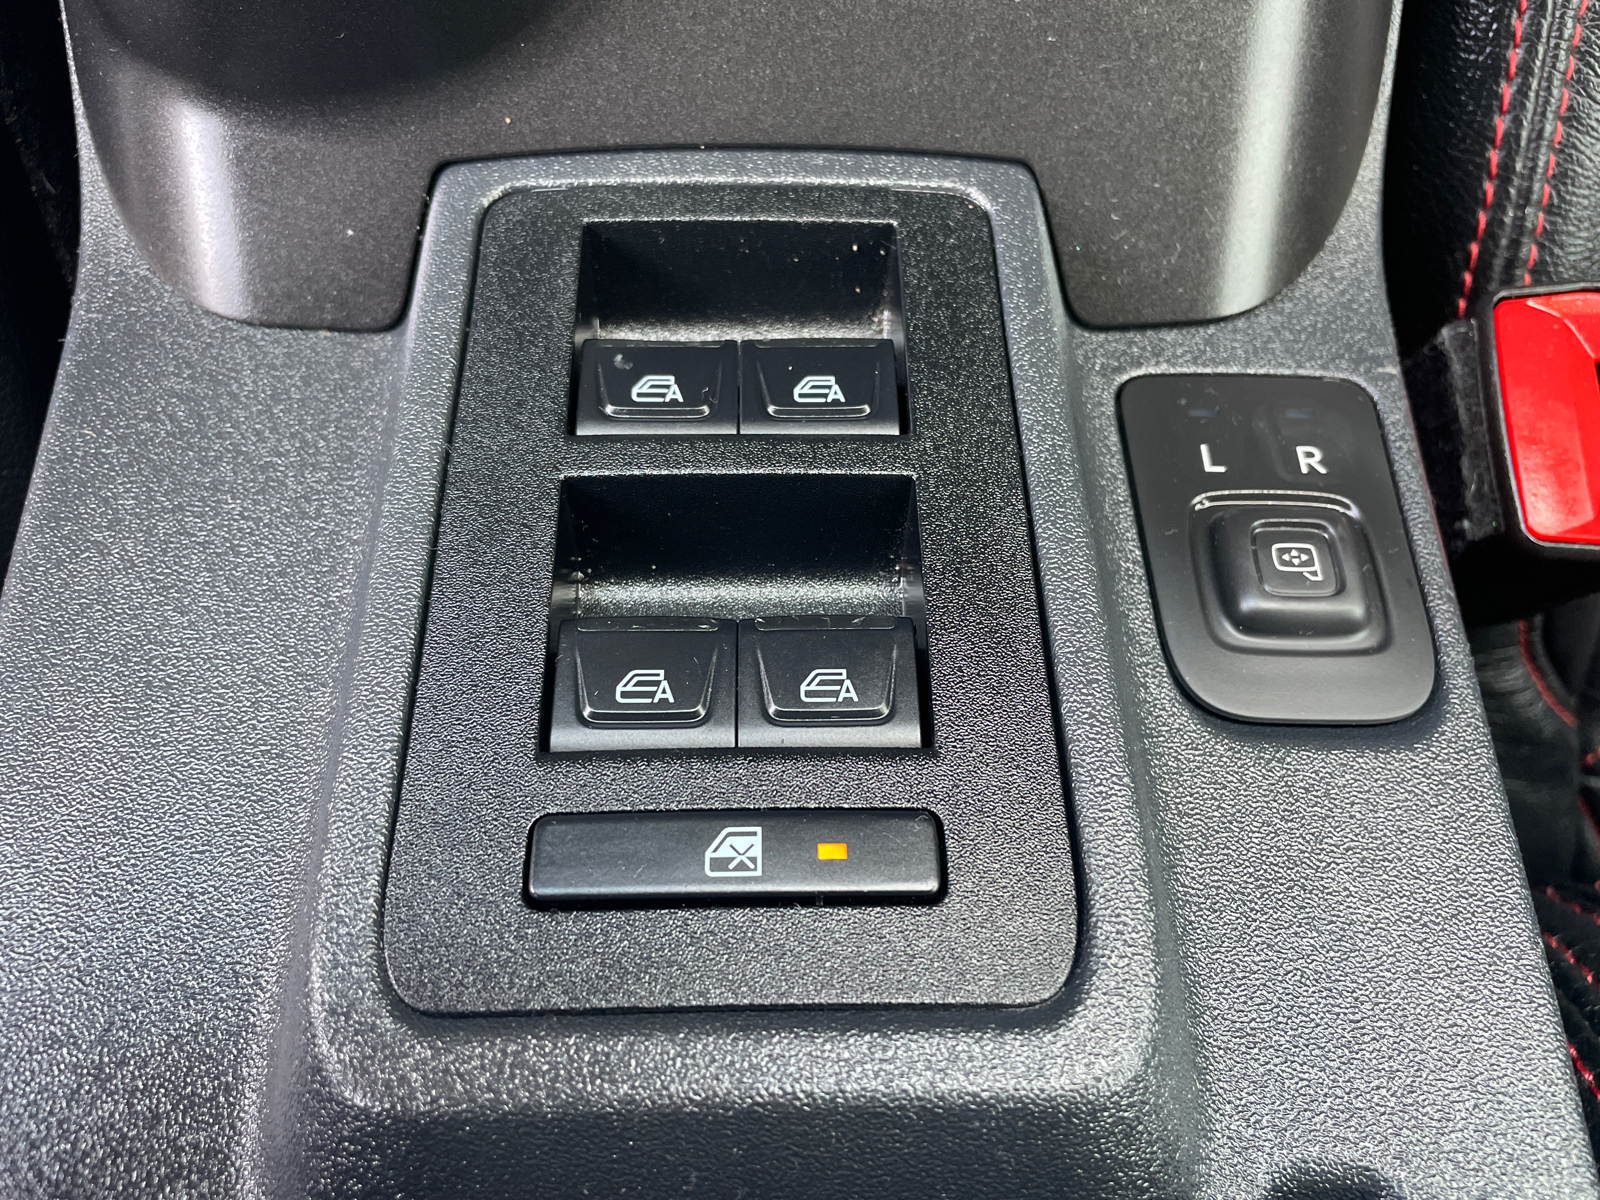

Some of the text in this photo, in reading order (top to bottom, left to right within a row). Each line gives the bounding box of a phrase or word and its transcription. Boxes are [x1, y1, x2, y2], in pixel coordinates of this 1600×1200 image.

[664, 383, 684, 403] A
[826, 383, 846, 403] A
[1200, 443, 1228, 473] L
[1295, 445, 1329, 475] R
[652, 679, 675, 704] A
[837, 678, 859, 703] A
